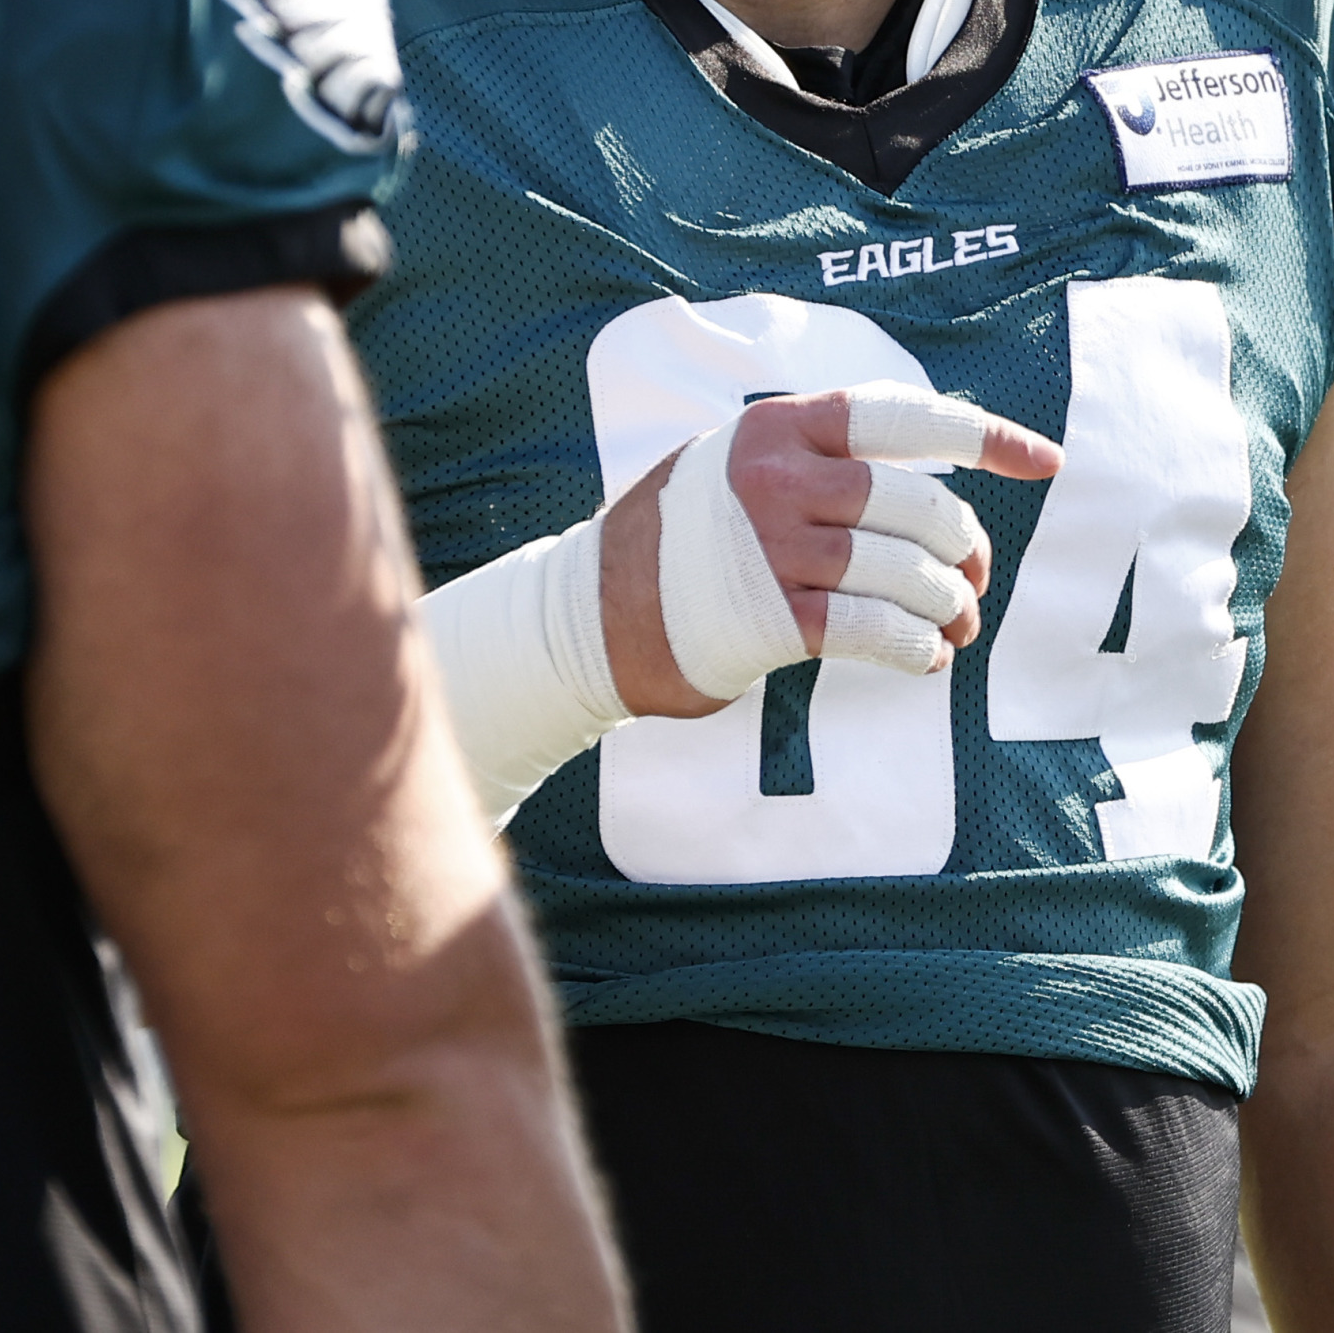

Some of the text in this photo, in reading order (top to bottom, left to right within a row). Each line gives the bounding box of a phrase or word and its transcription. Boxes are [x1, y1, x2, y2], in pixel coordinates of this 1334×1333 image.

[1154, 68, 1278, 102] Jefferson
[1166, 109, 1259, 148] Health
[817, 224, 1019, 287] EAGLES
